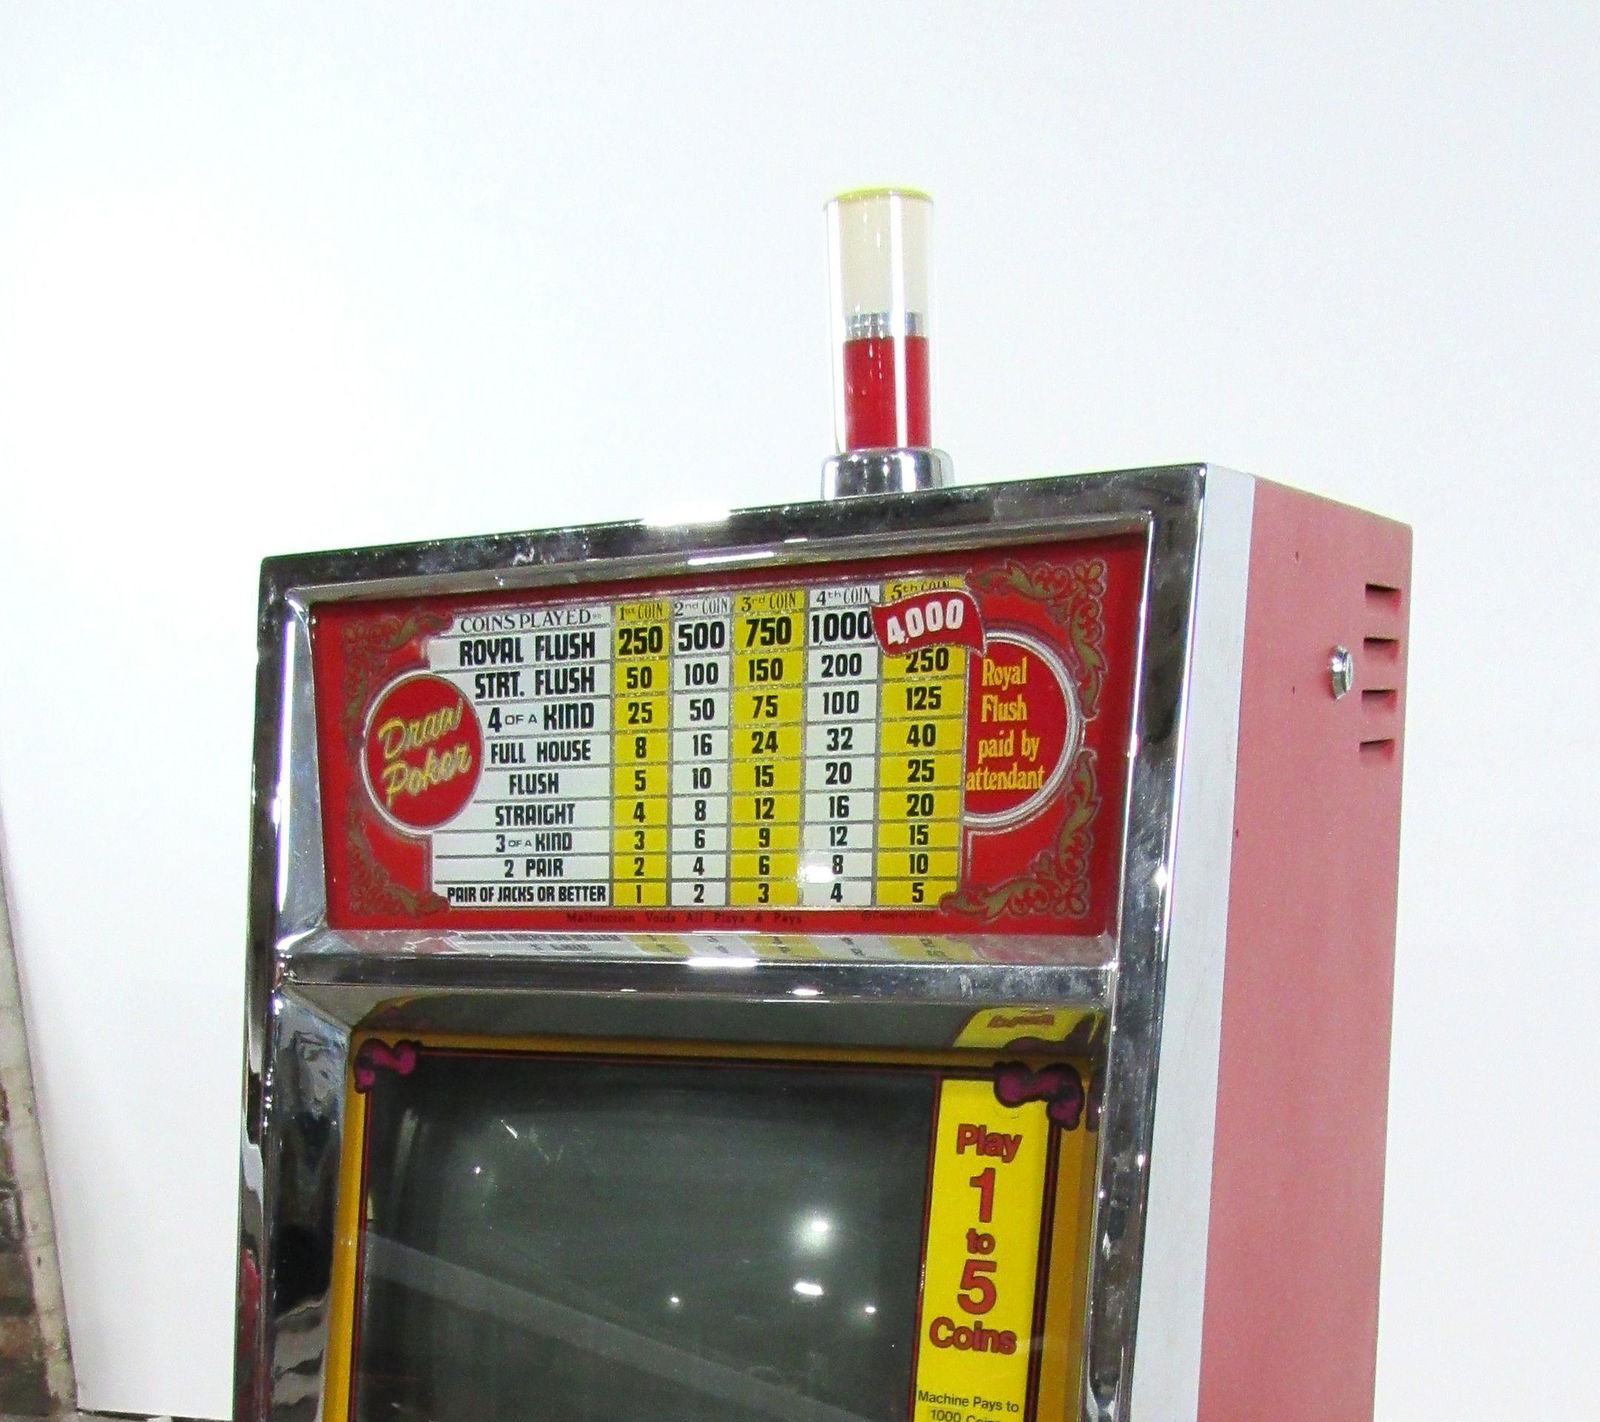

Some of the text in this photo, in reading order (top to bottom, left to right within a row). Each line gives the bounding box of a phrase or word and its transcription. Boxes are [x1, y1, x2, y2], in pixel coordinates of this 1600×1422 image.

[741, 591, 797, 613] 3rd COIN
[816, 586, 871, 607] 4th COIN
[891, 584, 918, 599] 5th
[461, 610, 591, 633] COINS PLAYED
[637, 604, 663, 619] COIN
[674, 599, 728, 617] 2nd COIN
[618, 626, 663, 655] 250
[678, 621, 725, 651] 500
[746, 616, 792, 646] 750
[887, 599, 964, 645] 4,000
[460, 632, 596, 666] ROYAL FLUSH
[626, 648, 949, 689] 50 100 150 200 250
[981, 656, 1028, 694] Royal
[475, 667, 595, 698] STRT. FLUSH
[488, 703, 594, 733] 4 OF A KIND
[628, 686, 941, 724] 25 50 75 100 125
[981, 696, 1028, 723] Flush
[377, 698, 464, 759] Draw
[635, 724, 936, 758] 8 16 24 32 40
[491, 739, 591, 764] FULL HOUSE
[978, 730, 1041, 765] paid by
[382, 742, 472, 806] Poker
[509, 773, 559, 795] FLUSH
[634, 759, 934, 792] 5 10 15 20 25
[966, 765, 1045, 792] attendant
[495, 803, 575, 826] STRAIGHT
[633, 794, 934, 823] 4 8 12 16 20
[496, 832, 573, 852] 3 OF A KIND
[634, 824, 929, 850] 3 6 9 12 15
[504, 859, 564, 878] 2 PAIR
[634, 853, 928, 876] 2 4 6 8 10
[447, 885, 606, 902] PAIR OF JACKS OR BETTER
[636, 882, 924, 904] 1 2 3 4 5
[956, 1123, 1023, 1164] Play
[969, 1167, 996, 1223] 1
[966, 1227, 996, 1255] to
[957, 1258, 997, 1315] 5
[929, 1316, 1017, 1355] Coins
[918, 1390, 1019, 1413] Machine Pays to
